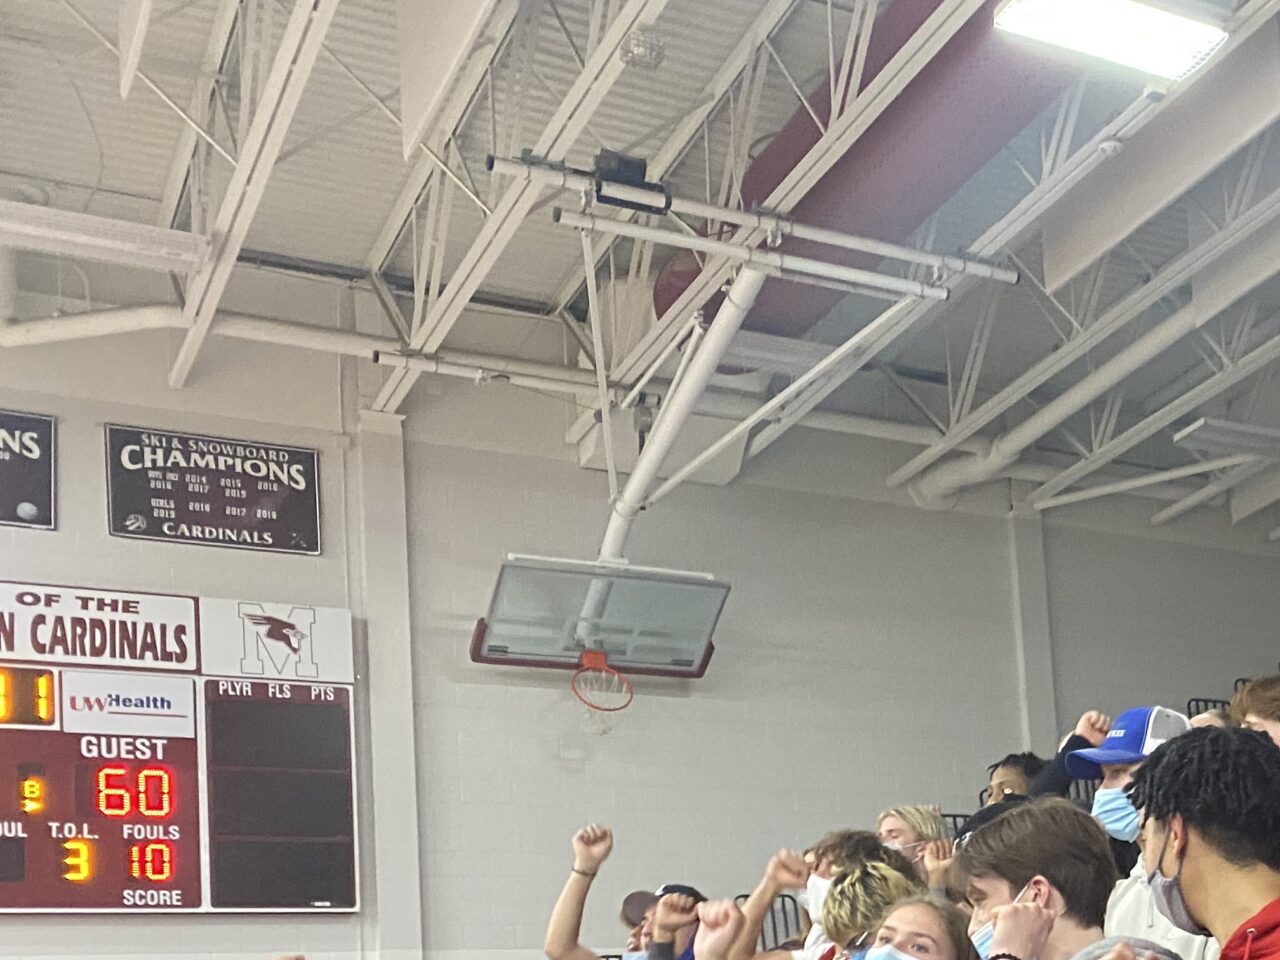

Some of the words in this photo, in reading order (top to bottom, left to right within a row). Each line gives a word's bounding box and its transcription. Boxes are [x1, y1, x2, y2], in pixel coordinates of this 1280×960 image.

[141, 434, 167, 447] SKI
[171, 437, 183, 449] &
[188, 439, 289, 462] SNOWBOARD
[120, 445, 306, 490] CHAMPIONS
[162, 522, 273, 545] CARDINALS
[16, 591, 61, 607] OF
[75, 596, 140, 614] THE
[31, 613, 188, 663] CARDINALS
[219, 681, 252, 696] PLYR
[268, 684, 291, 698] FLS
[311, 686, 335, 701] PTS
[80, 736, 168, 760] GUEST
[98, 768, 170, 816] 60
[0, 821, 28, 838] UL
[48, 822, 99, 839] T.O.L.
[122, 824, 180, 840] FOULS
[63, 841, 90, 880] 3
[131, 843, 170, 880] 10
[122, 889, 182, 906] SCORE
